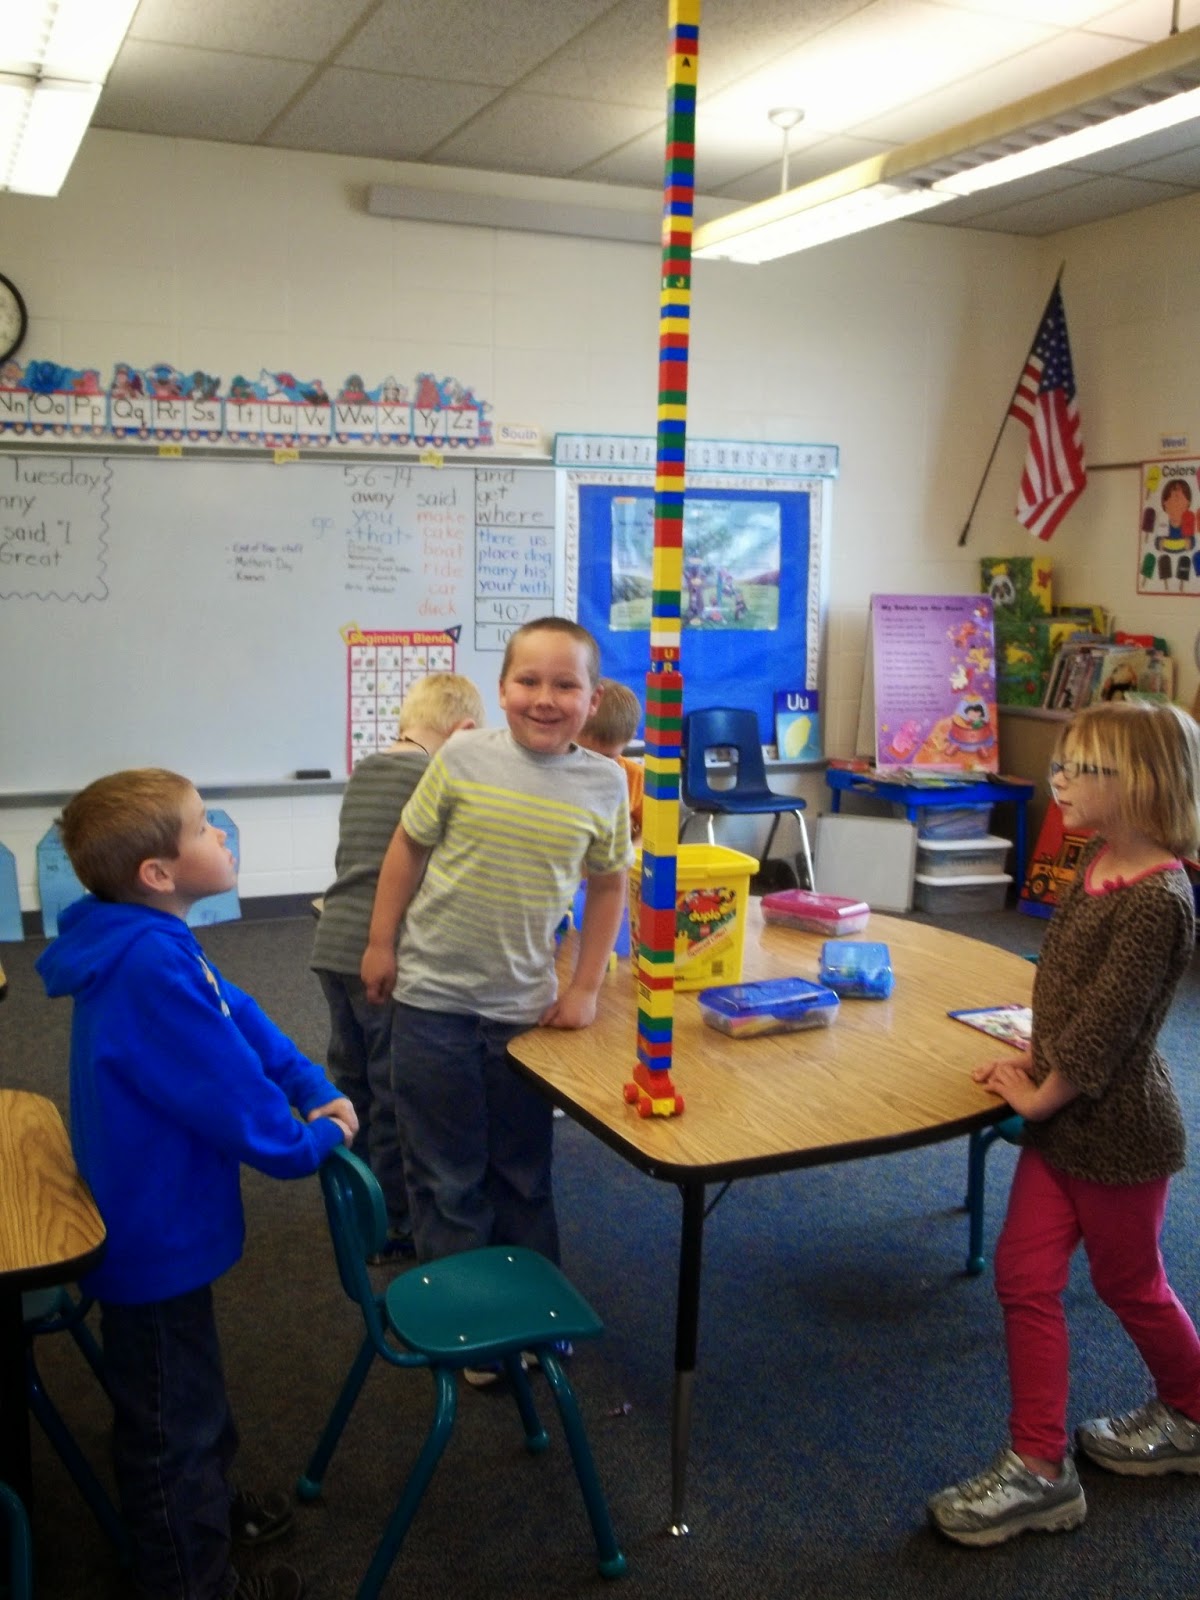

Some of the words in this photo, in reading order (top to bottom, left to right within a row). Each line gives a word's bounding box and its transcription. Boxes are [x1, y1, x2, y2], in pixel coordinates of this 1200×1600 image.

[682, 56, 691, 68] A
[34, 394, 65, 414] Oo
[74, 395, 101, 425] Pp
[114, 399, 146, 427] Qq
[157, 400, 181, 419] Rr
[192, 400, 215, 420] Ss
[267, 406, 292, 424] Uu
[304, 407, 325, 426] Vv
[337, 405, 375, 424] Ww
[382, 406, 406, 426] Xx
[420, 409, 439, 437] Yy
[452, 410, 473, 429] Zz
[502, 428, 538, 441] South
[9, 456, 100, 495] Tuesday
[1162, 465, 1196, 477] Colors
[352, 492, 395, 509] away
[417, 487, 456, 507] said
[477, 486, 509, 508] get
[352, 510, 393, 530] you
[416, 509, 465, 523] make
[478, 503, 544, 523] where
[479, 528, 516, 546] there
[530, 535, 548, 546] us
[479, 545, 520, 561] place
[478, 564, 517, 584] many
[524, 564, 548, 578] his
[479, 579, 518, 593] your
[521, 580, 552, 594] with
[418, 598, 458, 616] duck
[493, 602, 531, 620] 407
[351, 632, 411, 646] Beginning
[413, 631, 453, 644] Blends
[664, 648, 674, 660] U
[787, 693, 810, 711] Uu
